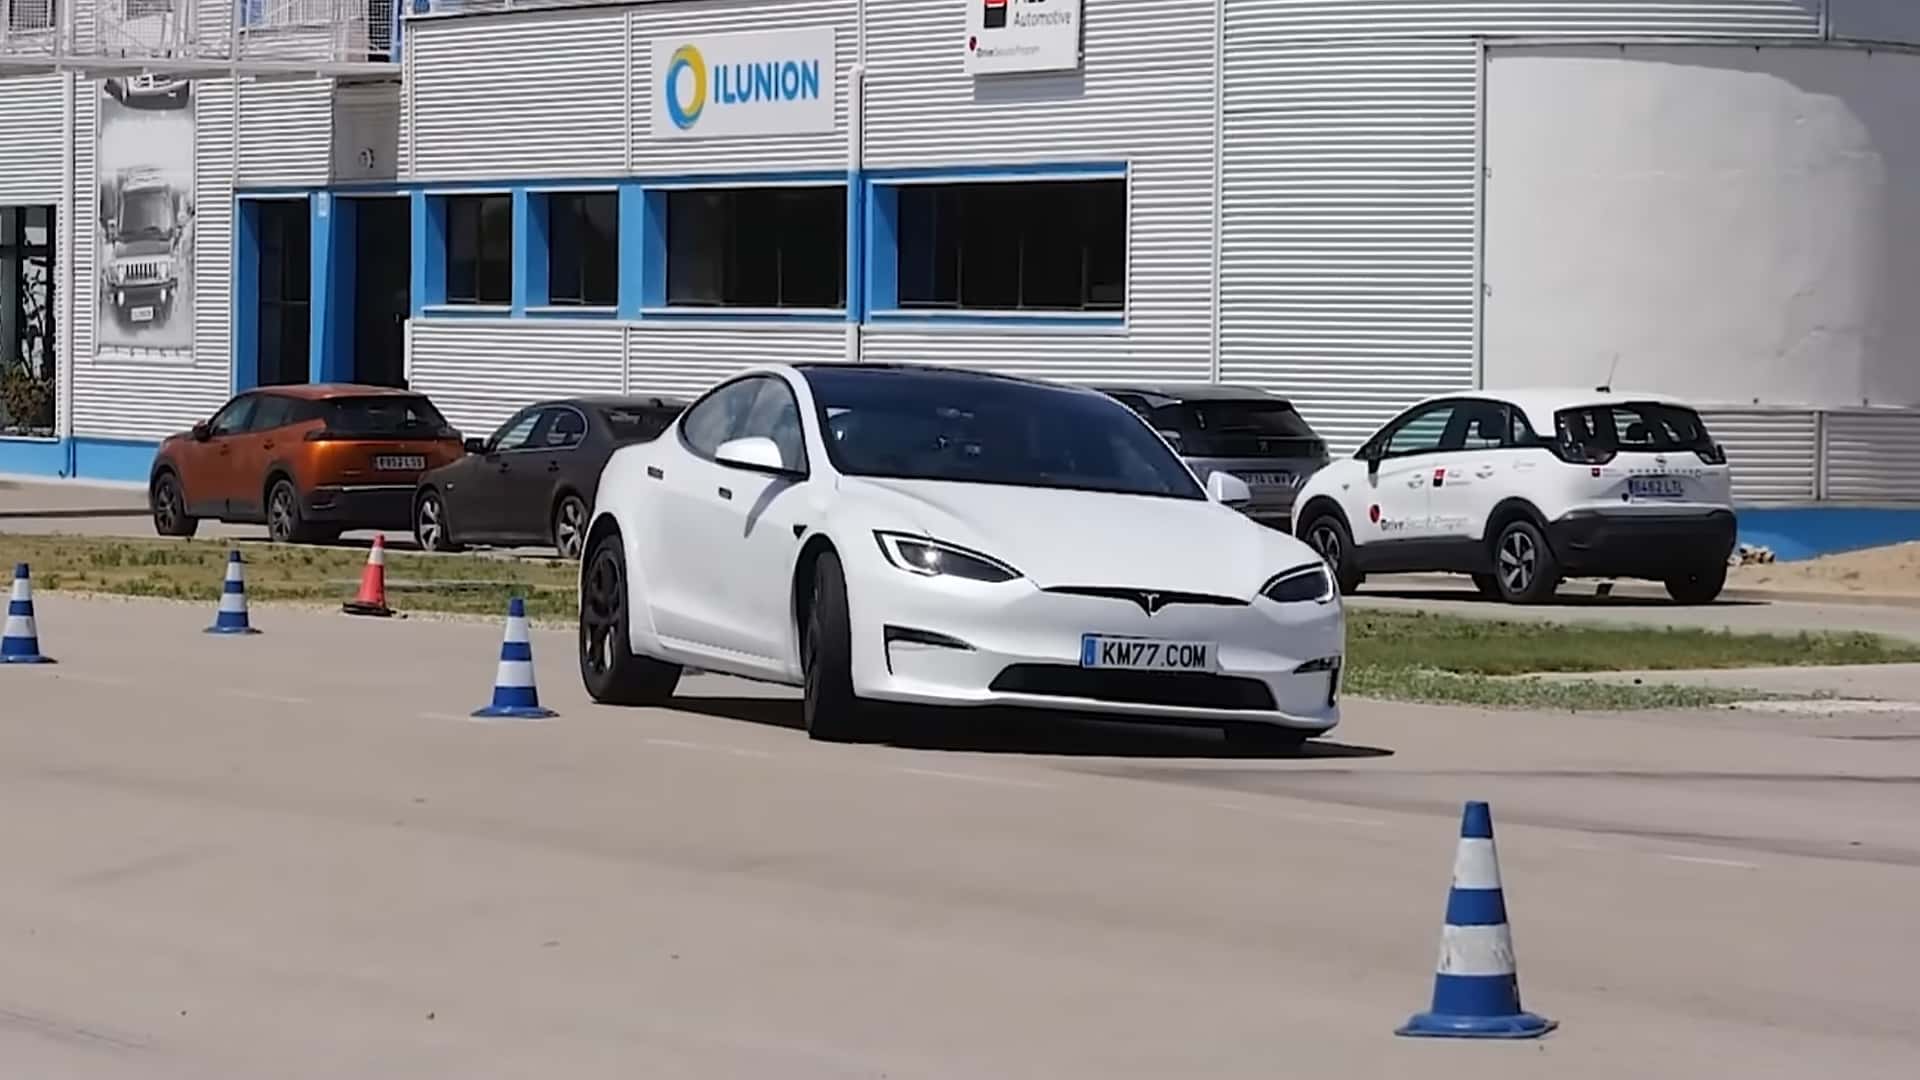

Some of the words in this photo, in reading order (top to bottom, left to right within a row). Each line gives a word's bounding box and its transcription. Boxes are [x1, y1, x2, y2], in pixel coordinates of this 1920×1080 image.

[1014, 10, 1071, 27] Automotive
[714, 59, 819, 104] ILUNION
[1102, 641, 1206, 668] KM77.COM
